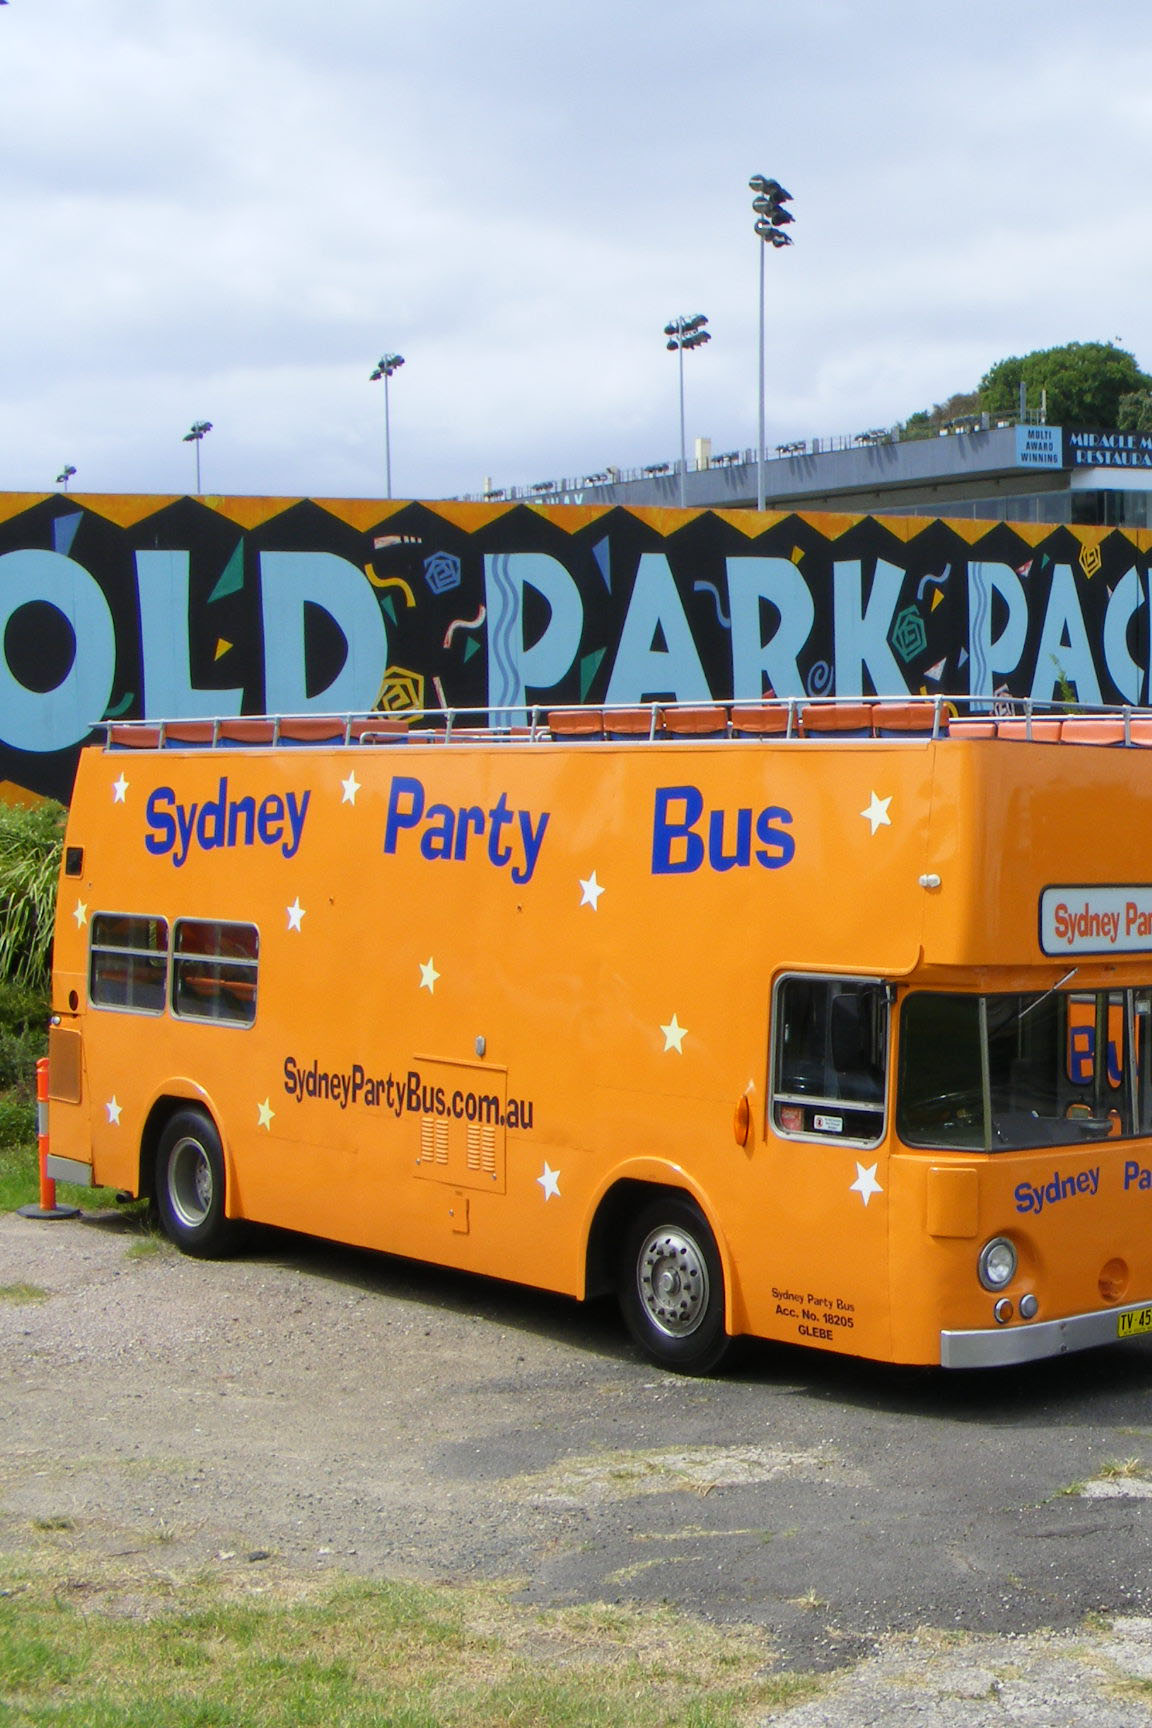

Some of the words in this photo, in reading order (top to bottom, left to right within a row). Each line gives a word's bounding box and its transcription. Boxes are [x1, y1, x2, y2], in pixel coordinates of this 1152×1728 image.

[1025, 441, 1054, 452] AWARD
[1027, 429, 1052, 440] MULTI
[1070, 433, 1137, 449] MIRACLE
[1020, 453, 1059, 463] WINNING
[484, 553, 910, 733] PARK
[145, 776, 311, 868] Sydney
[383, 776, 551, 885] Party
[651, 785, 795, 875] Bus
[1054, 902, 1120, 945] Sydney
[284, 1056, 533, 1129] SydneyPartyBus.com.au
[1013, 1166, 1100, 1214] Sydney
[771, 1287, 804, 1304] Sydney
[807, 1293, 833, 1309] Party
[836, 1298, 855, 1312] Bus
[775, 1304, 799, 1318] Acc.
[802, 1308, 819, 1322] No.
[822, 1313, 854, 1328] 18205
[798, 1324, 833, 1340] GLEBE
